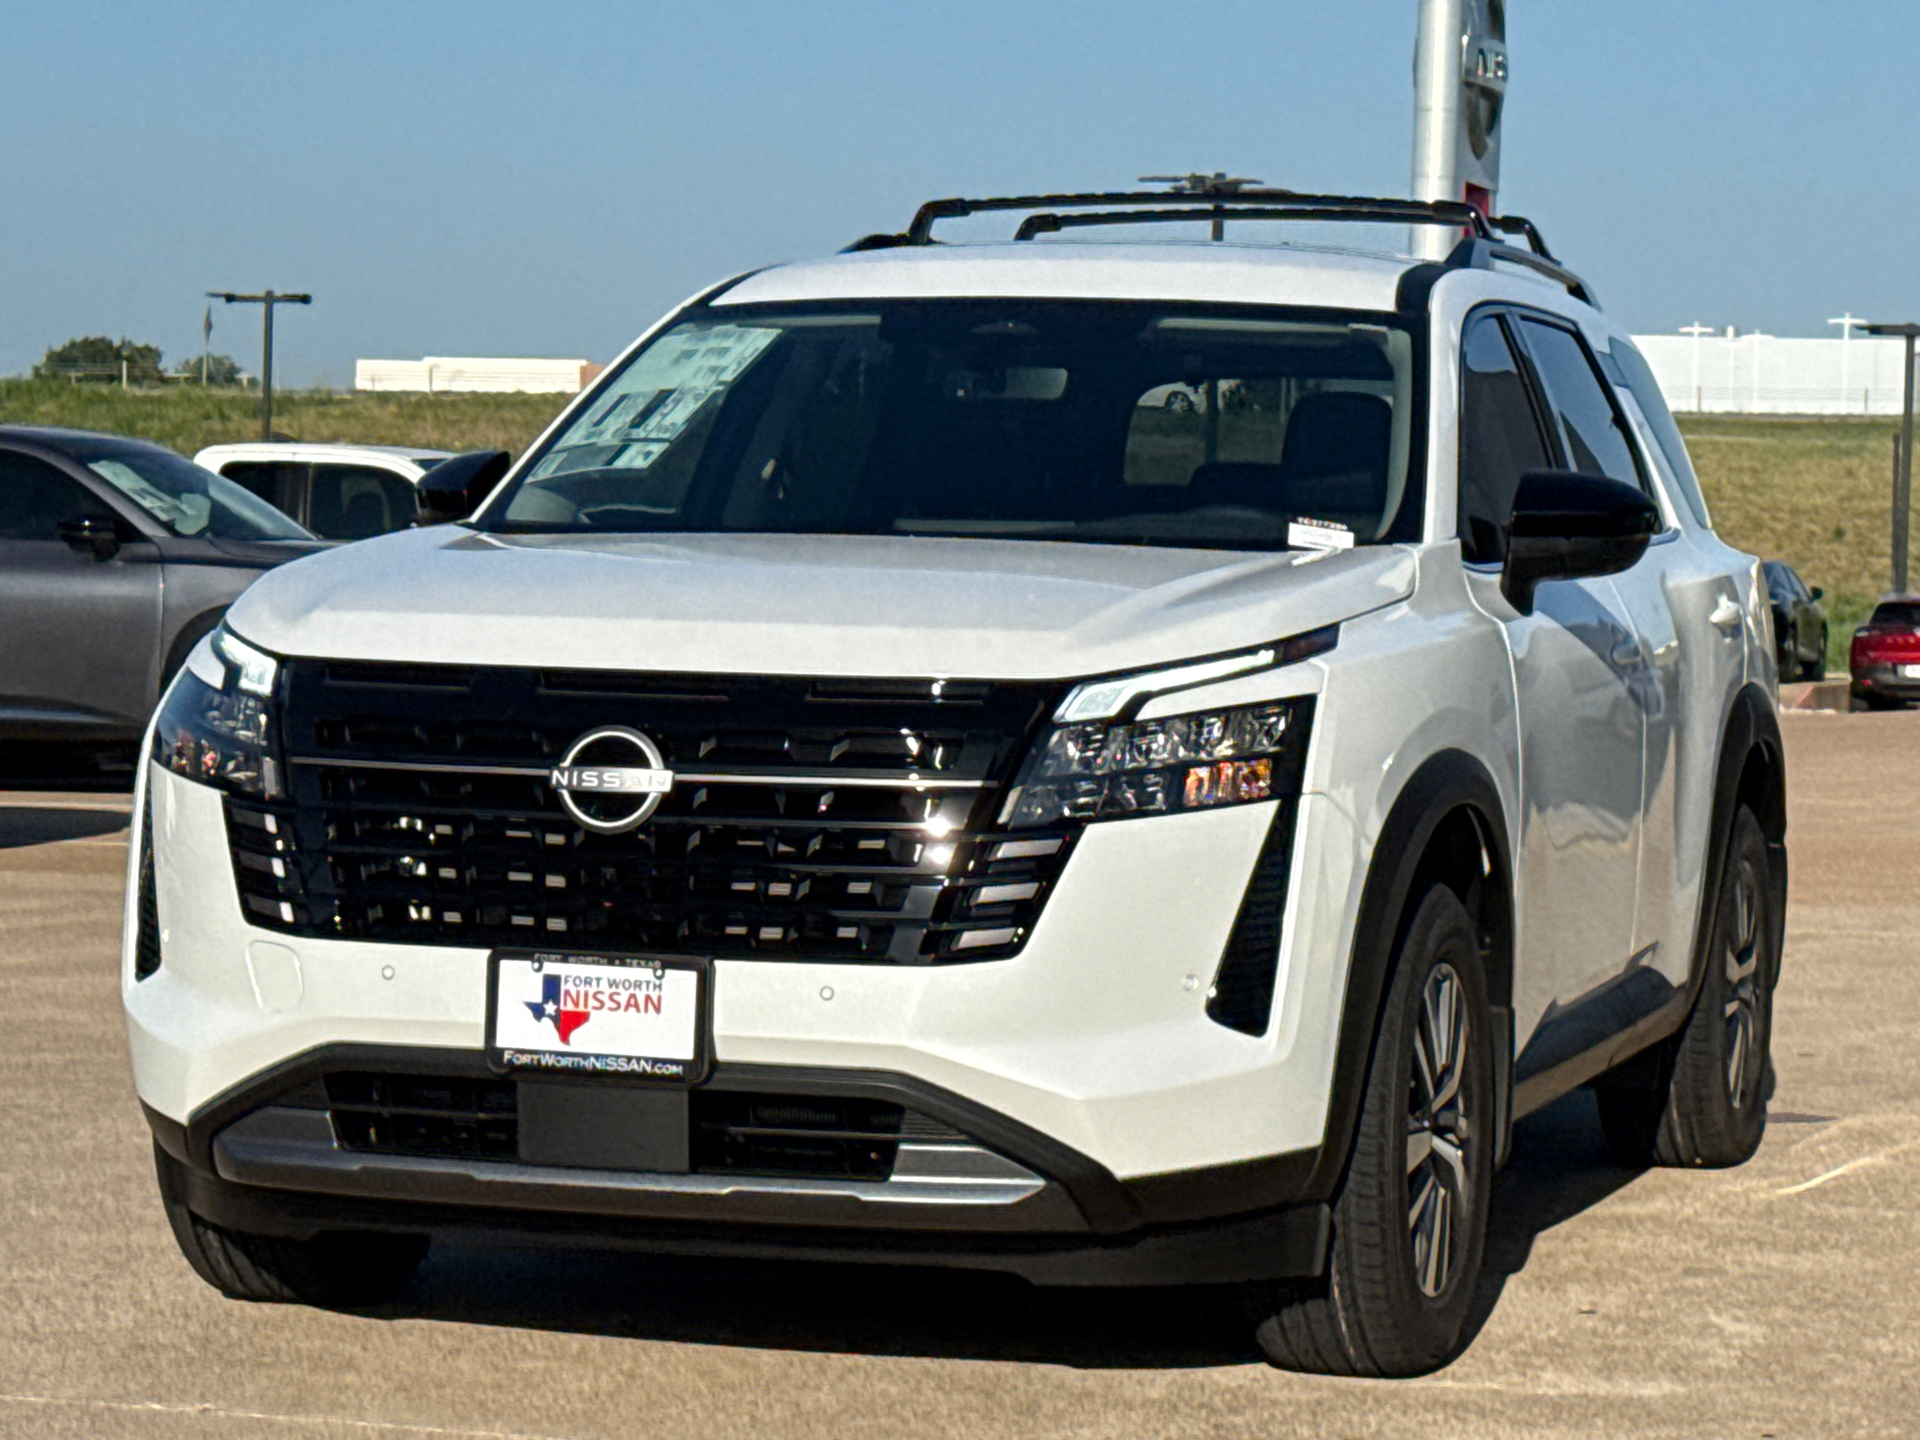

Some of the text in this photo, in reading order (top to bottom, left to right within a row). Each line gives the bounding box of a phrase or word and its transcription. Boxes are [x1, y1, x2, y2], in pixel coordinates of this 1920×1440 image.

[552, 770, 667, 788] NISSAN
[563, 974, 663, 993] FORT WORTH
[563, 989, 662, 1015] NISSAN
